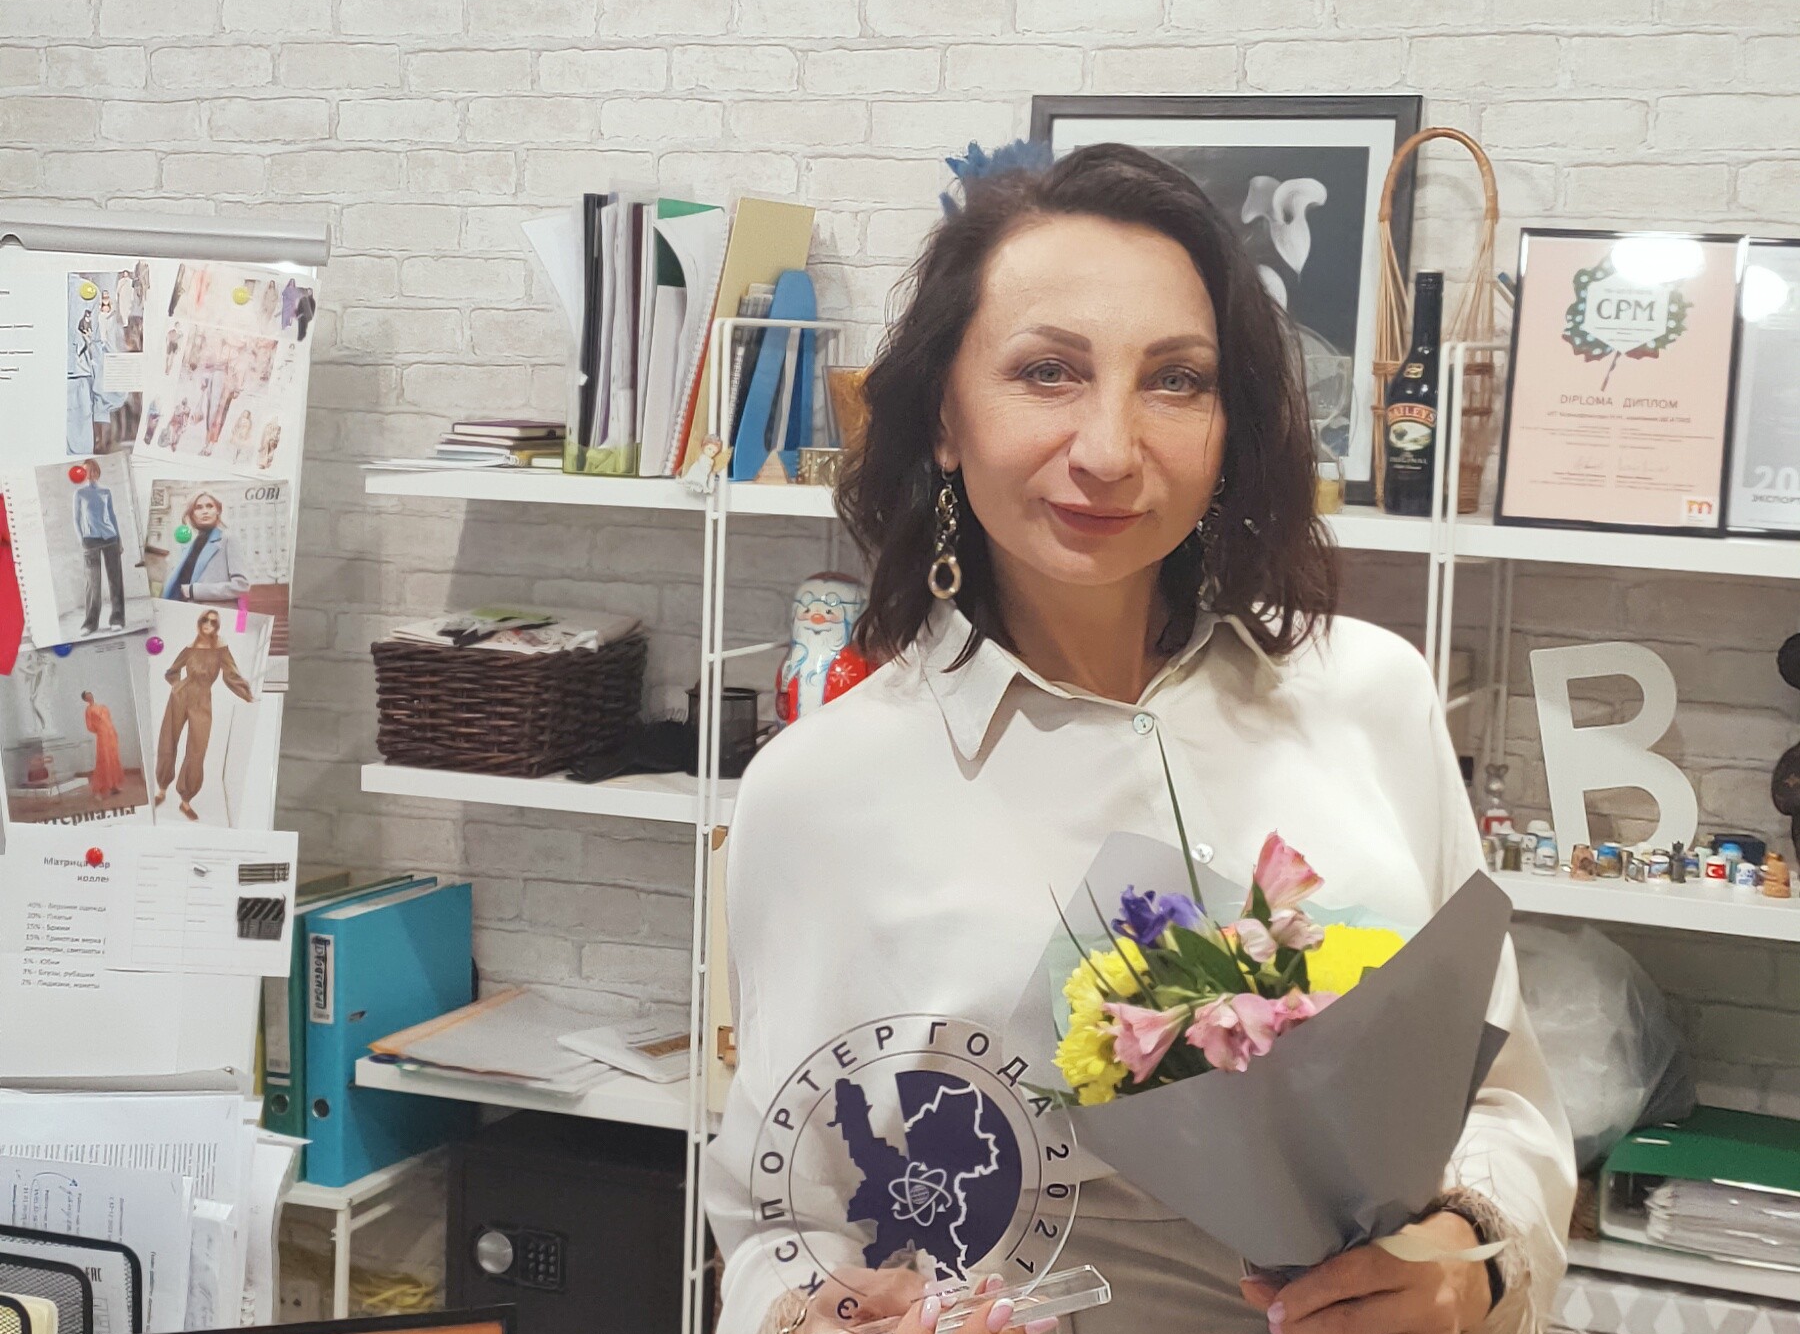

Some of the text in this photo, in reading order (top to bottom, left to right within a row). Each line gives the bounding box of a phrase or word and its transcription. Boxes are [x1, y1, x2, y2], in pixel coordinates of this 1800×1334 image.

[1596, 298, 1656, 322] CPM
[1560, 394, 1613, 406] DIPLOMA
[1623, 397, 1678, 409] ДИПЛОМ
[244, 486, 280, 501] GOBI
[759, 1021, 1070, 1320] ЭКСПОРТЕР ГОДА 2021
